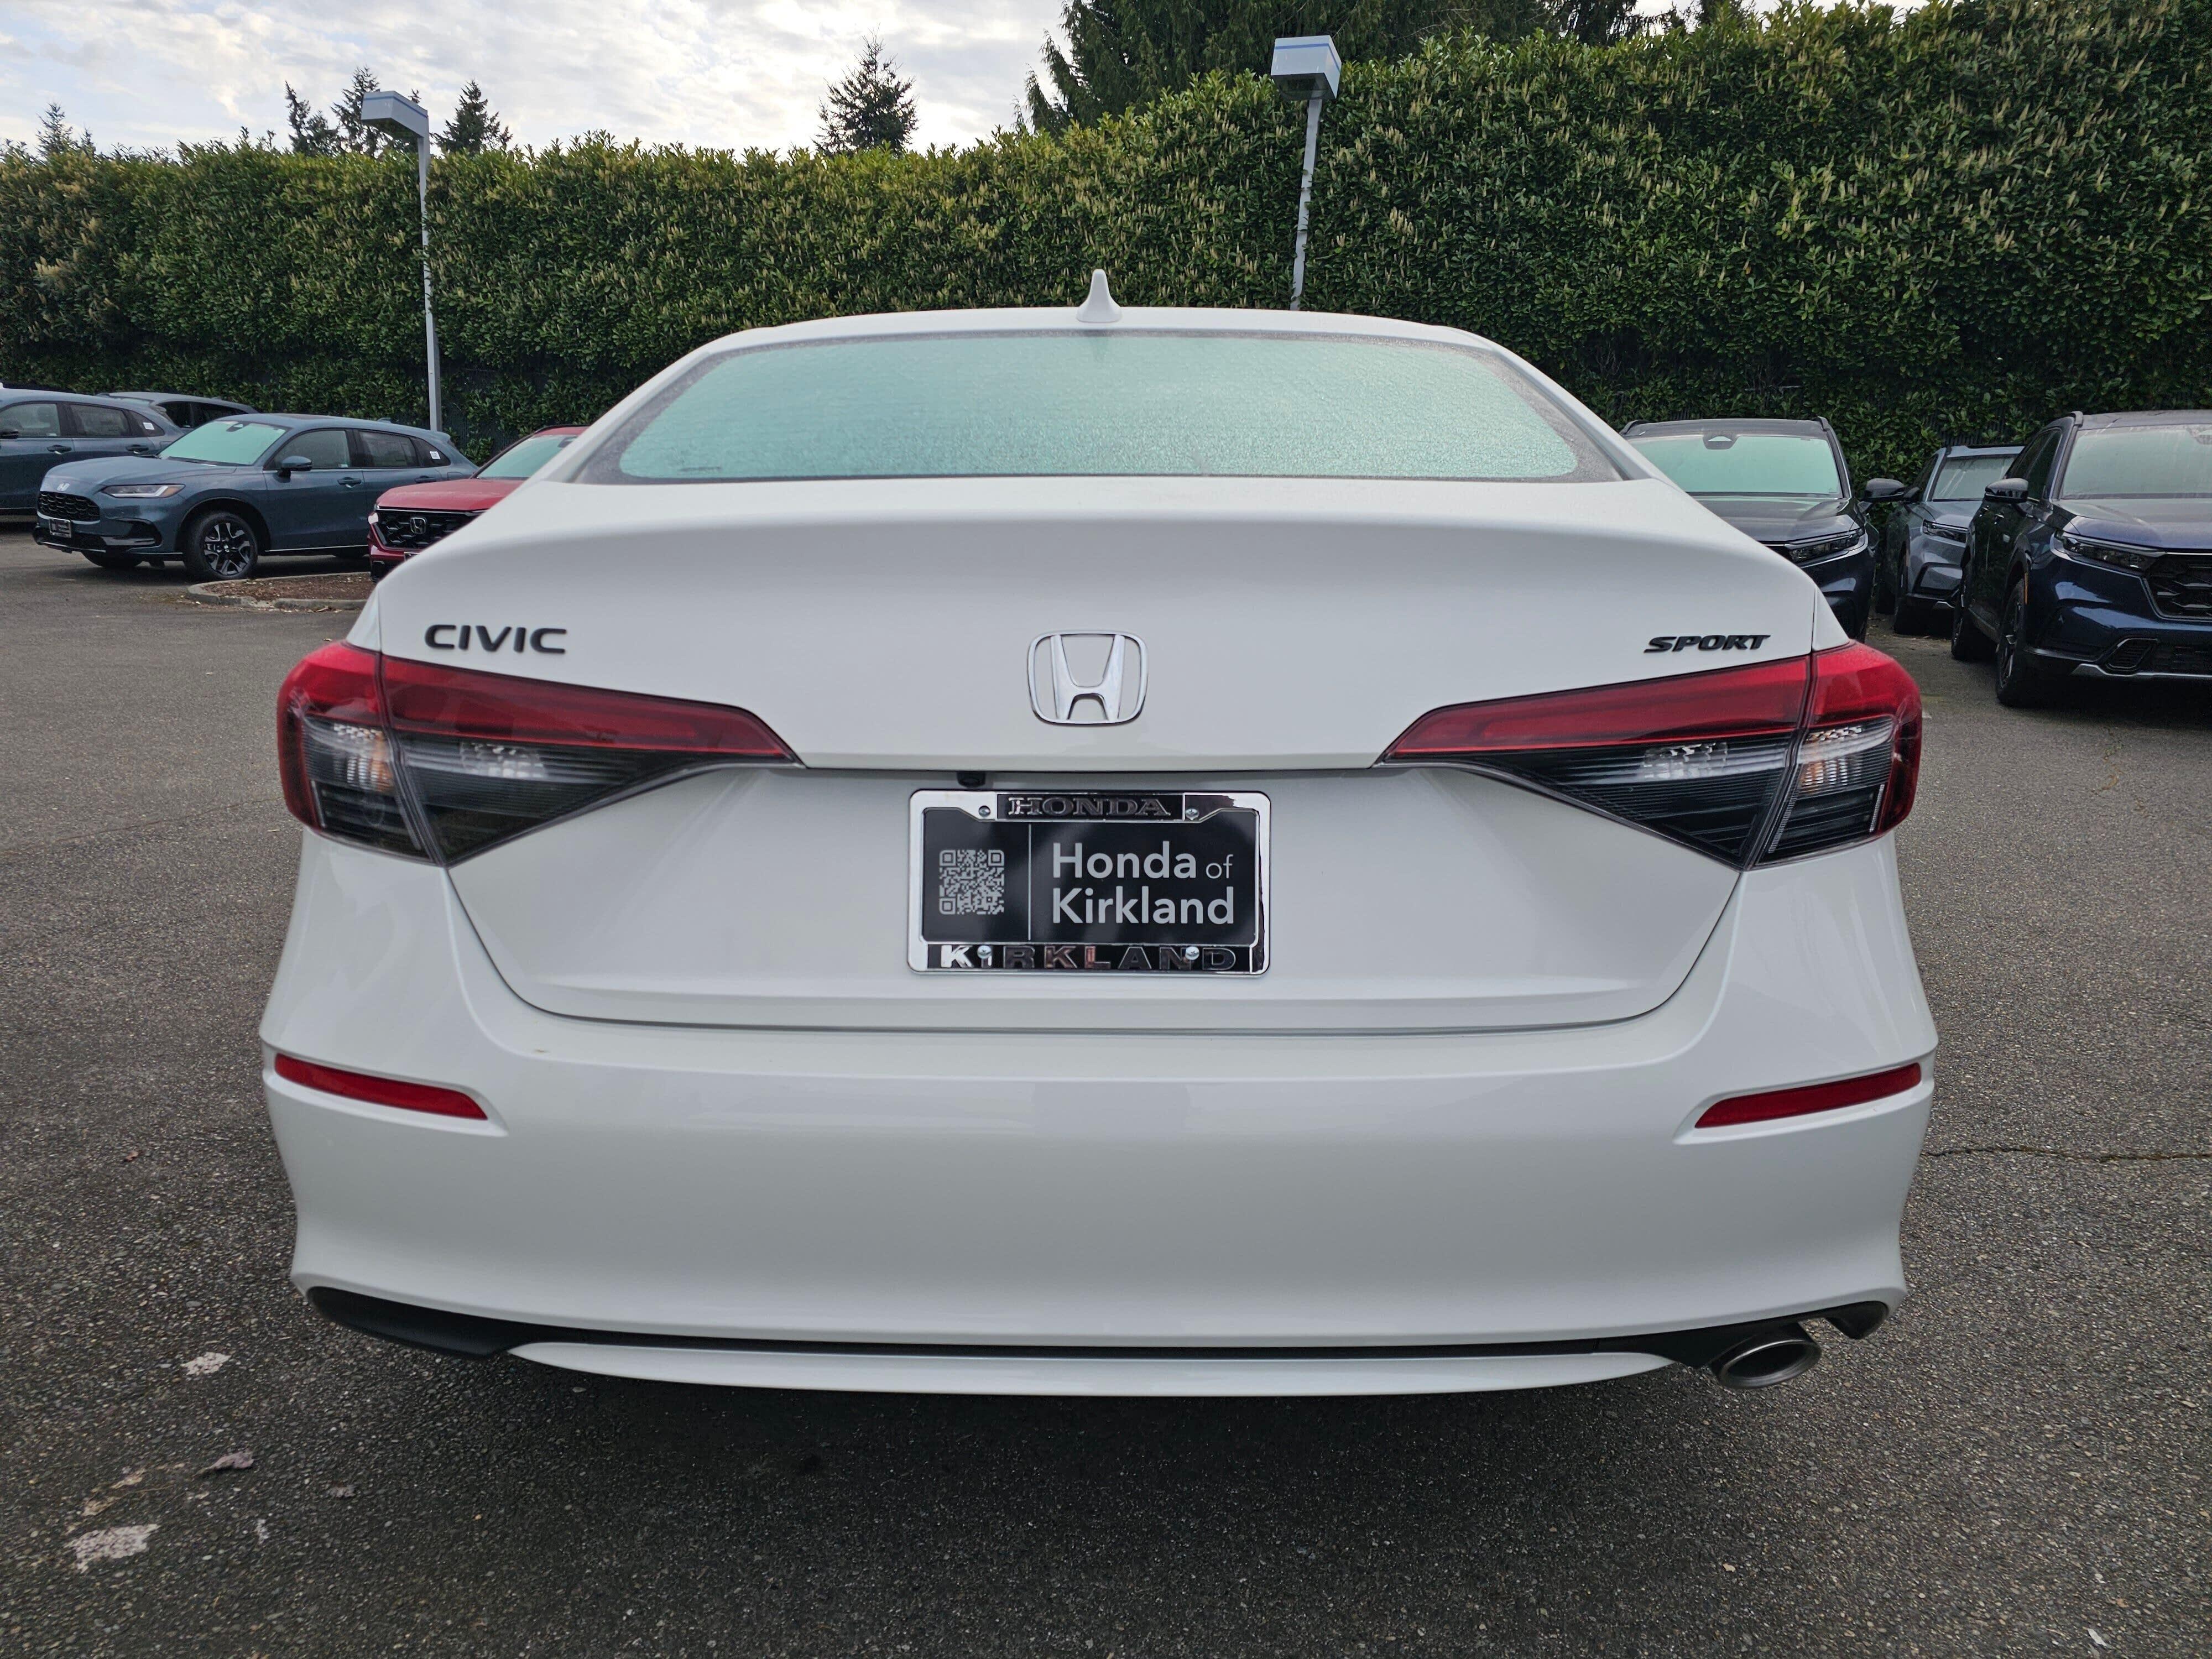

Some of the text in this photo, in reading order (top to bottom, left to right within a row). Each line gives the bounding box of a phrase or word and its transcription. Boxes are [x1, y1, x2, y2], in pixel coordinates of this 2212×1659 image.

[424, 624, 567, 654] CIVIC
[1643, 634, 1771, 653] SPORT
[1008, 796, 1171, 816] HONDA
[1052, 841, 1234, 879] Honda of
[1052, 885, 1234, 925] Kirkland
